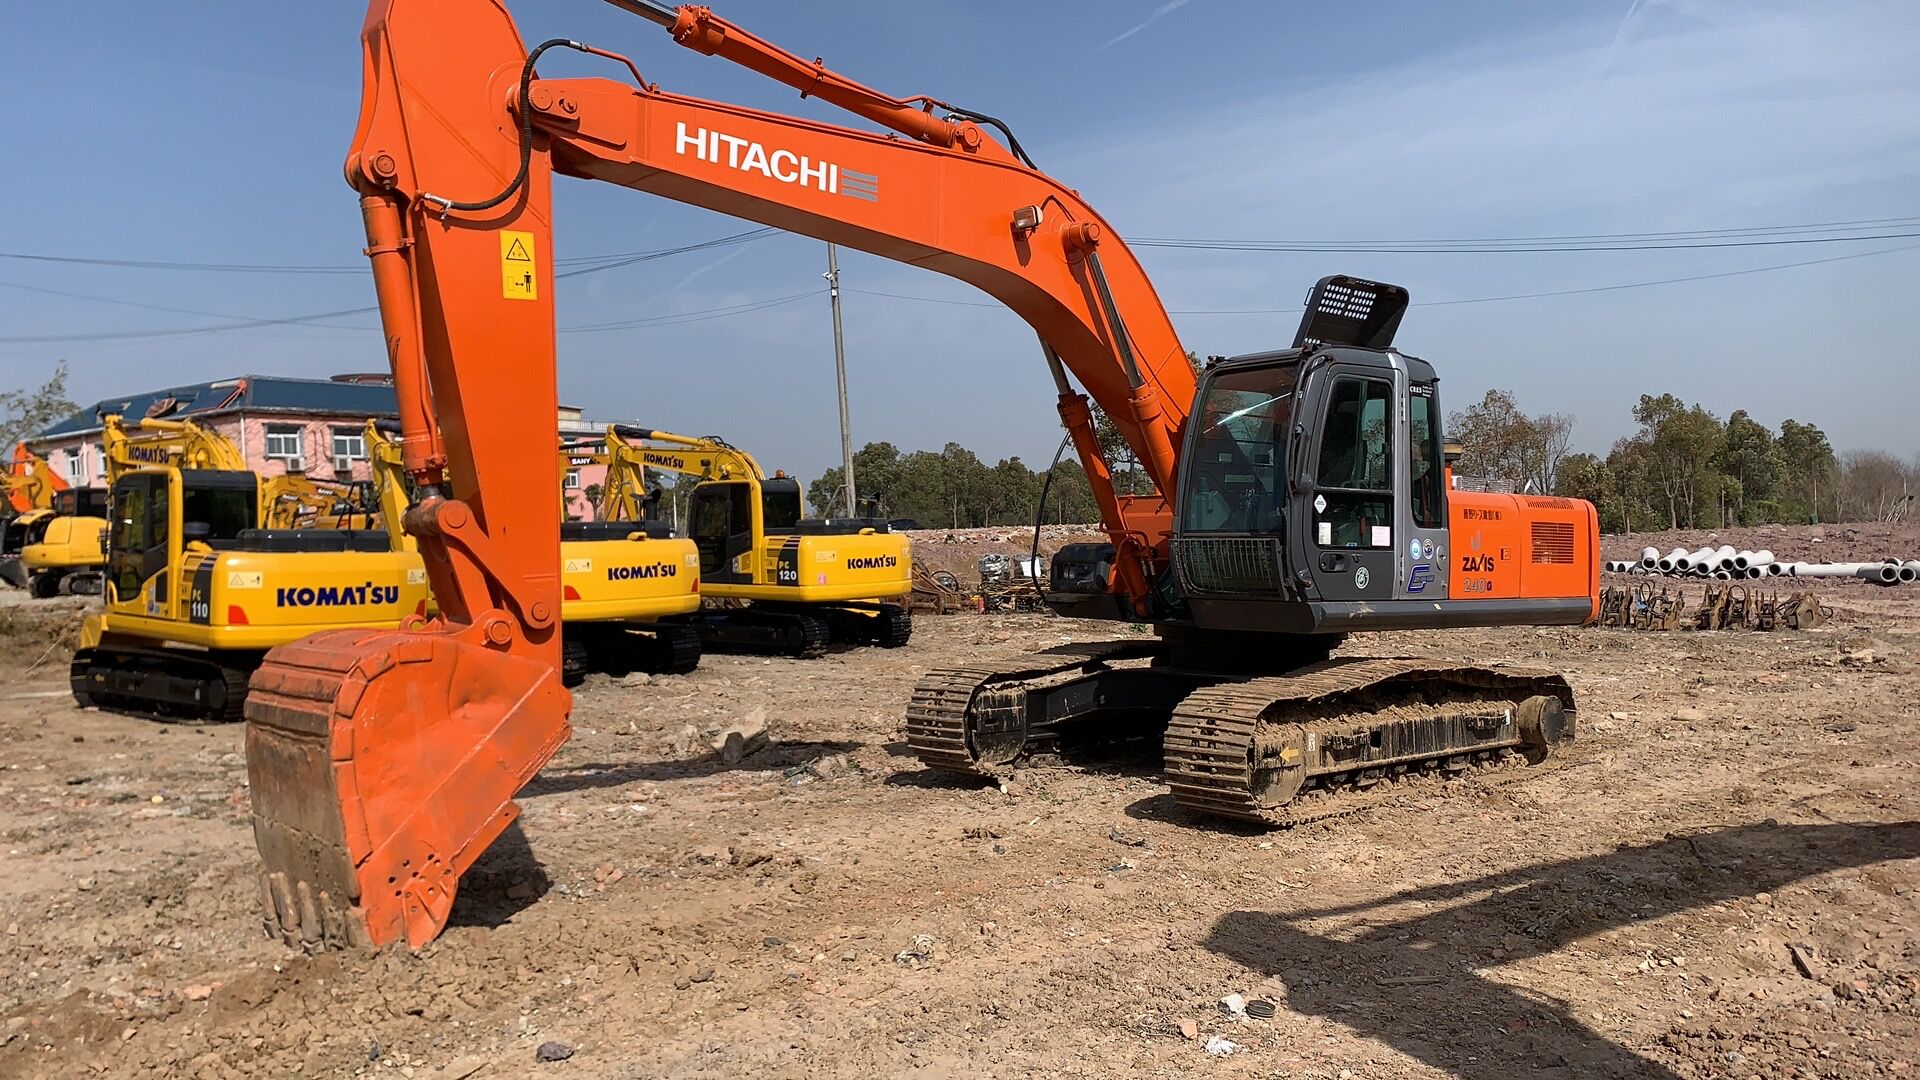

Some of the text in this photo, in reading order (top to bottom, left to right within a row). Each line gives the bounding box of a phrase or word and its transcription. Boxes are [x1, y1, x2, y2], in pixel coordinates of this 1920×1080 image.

[675, 121, 838, 194] HITACHI
[129, 445, 169, 464] KOMATSU
[643, 453, 684, 469] KOMATSU
[779, 561, 789, 569] PC
[847, 554, 896, 569] KOMATSU
[607, 561, 676, 580] KOMATSU
[779, 570, 797, 580] 120
[277, 581, 399, 607] KOMATSU
[192, 601, 208, 618] 110
